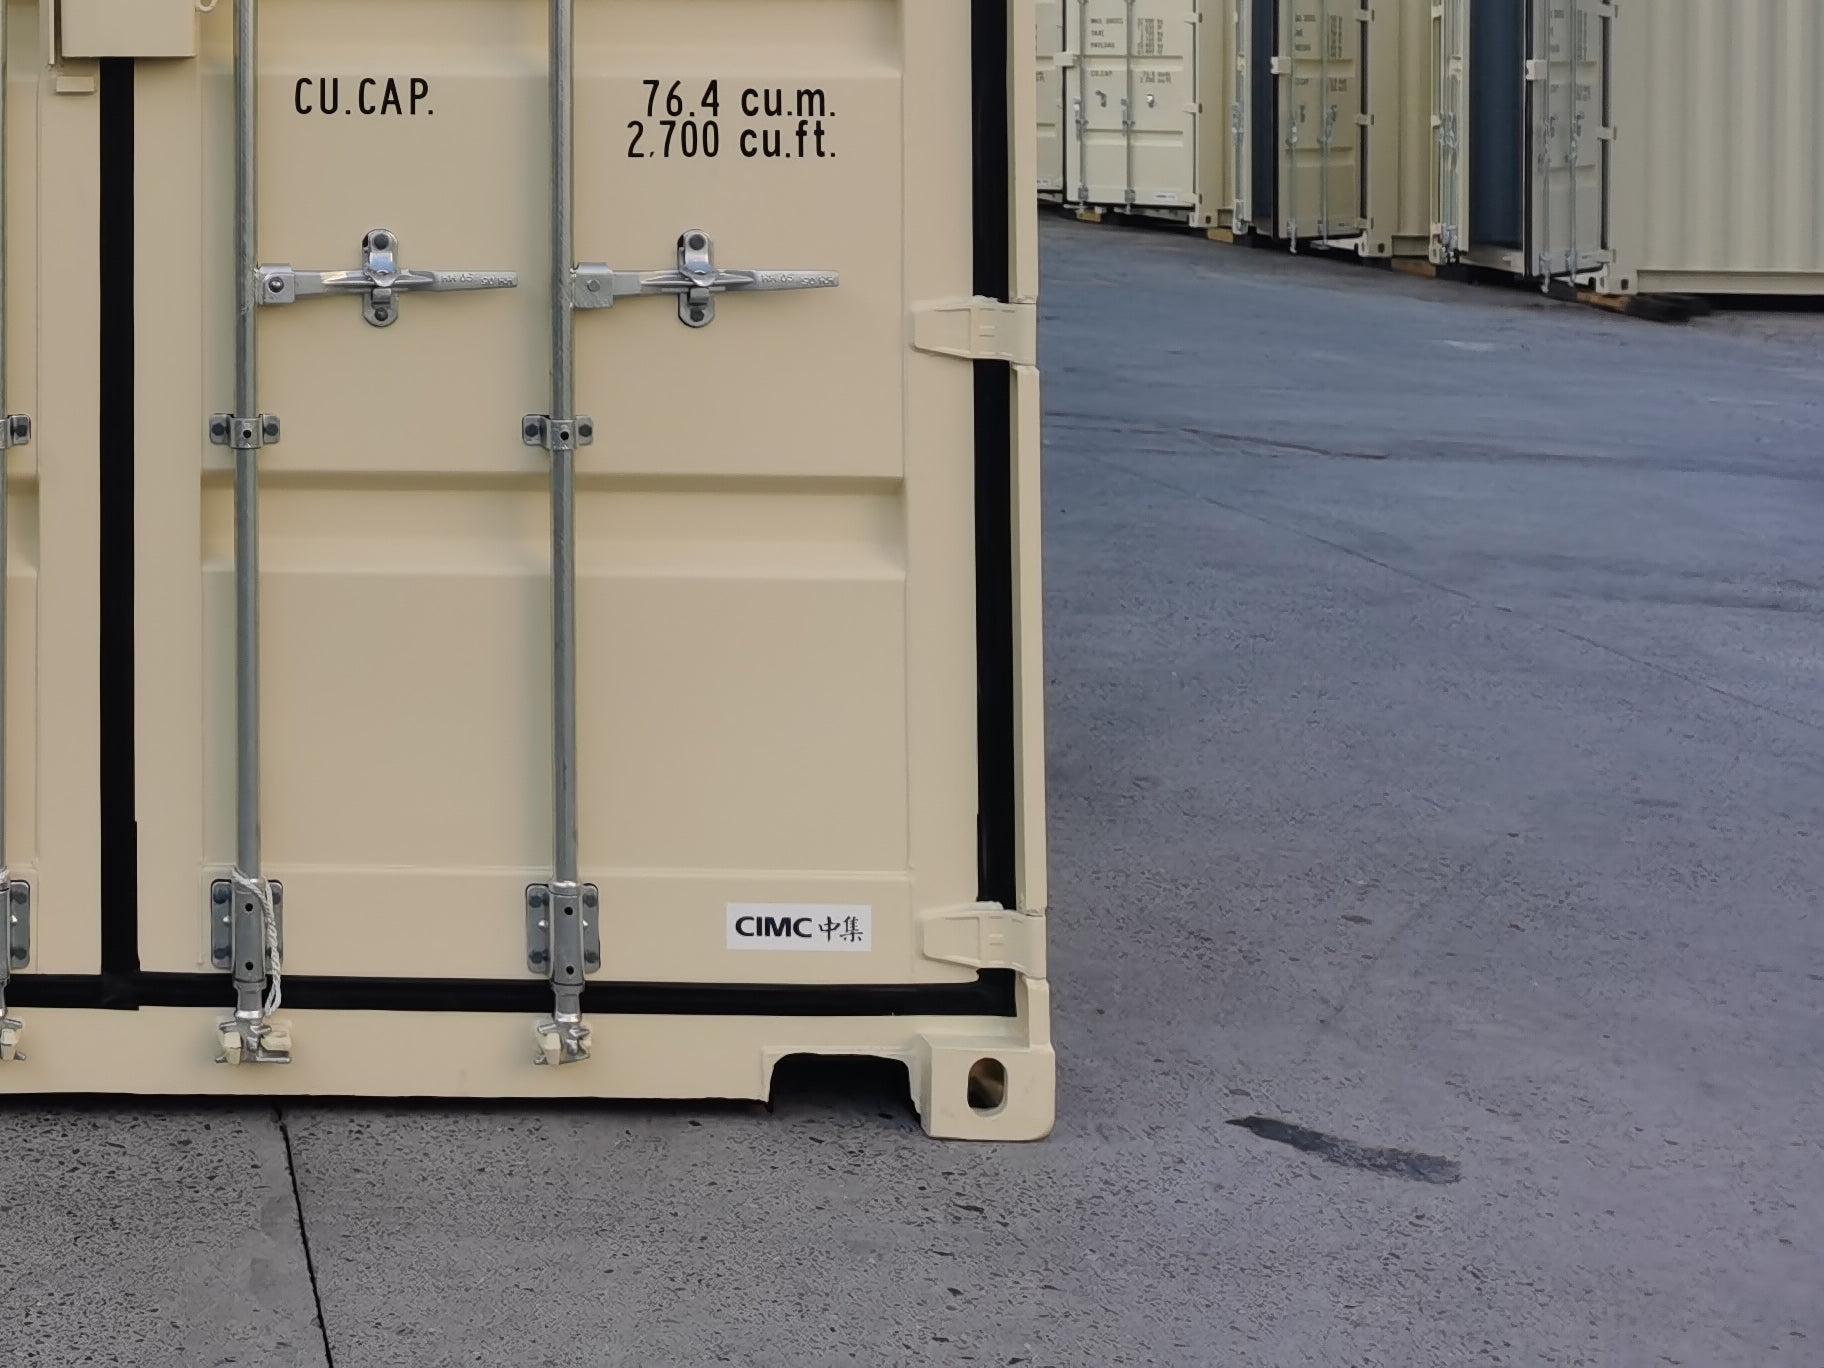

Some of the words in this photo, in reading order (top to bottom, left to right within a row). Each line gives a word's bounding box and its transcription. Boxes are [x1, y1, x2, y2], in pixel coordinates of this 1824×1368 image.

[294, 77, 434, 116] CU.CAP.
[642, 79, 720, 117] 76.4
[741, 88, 836, 117] cu.m.
[739, 119, 836, 158] cu.ft.
[734, 916, 813, 938] CIMC
[818, 916, 864, 943] 中集
